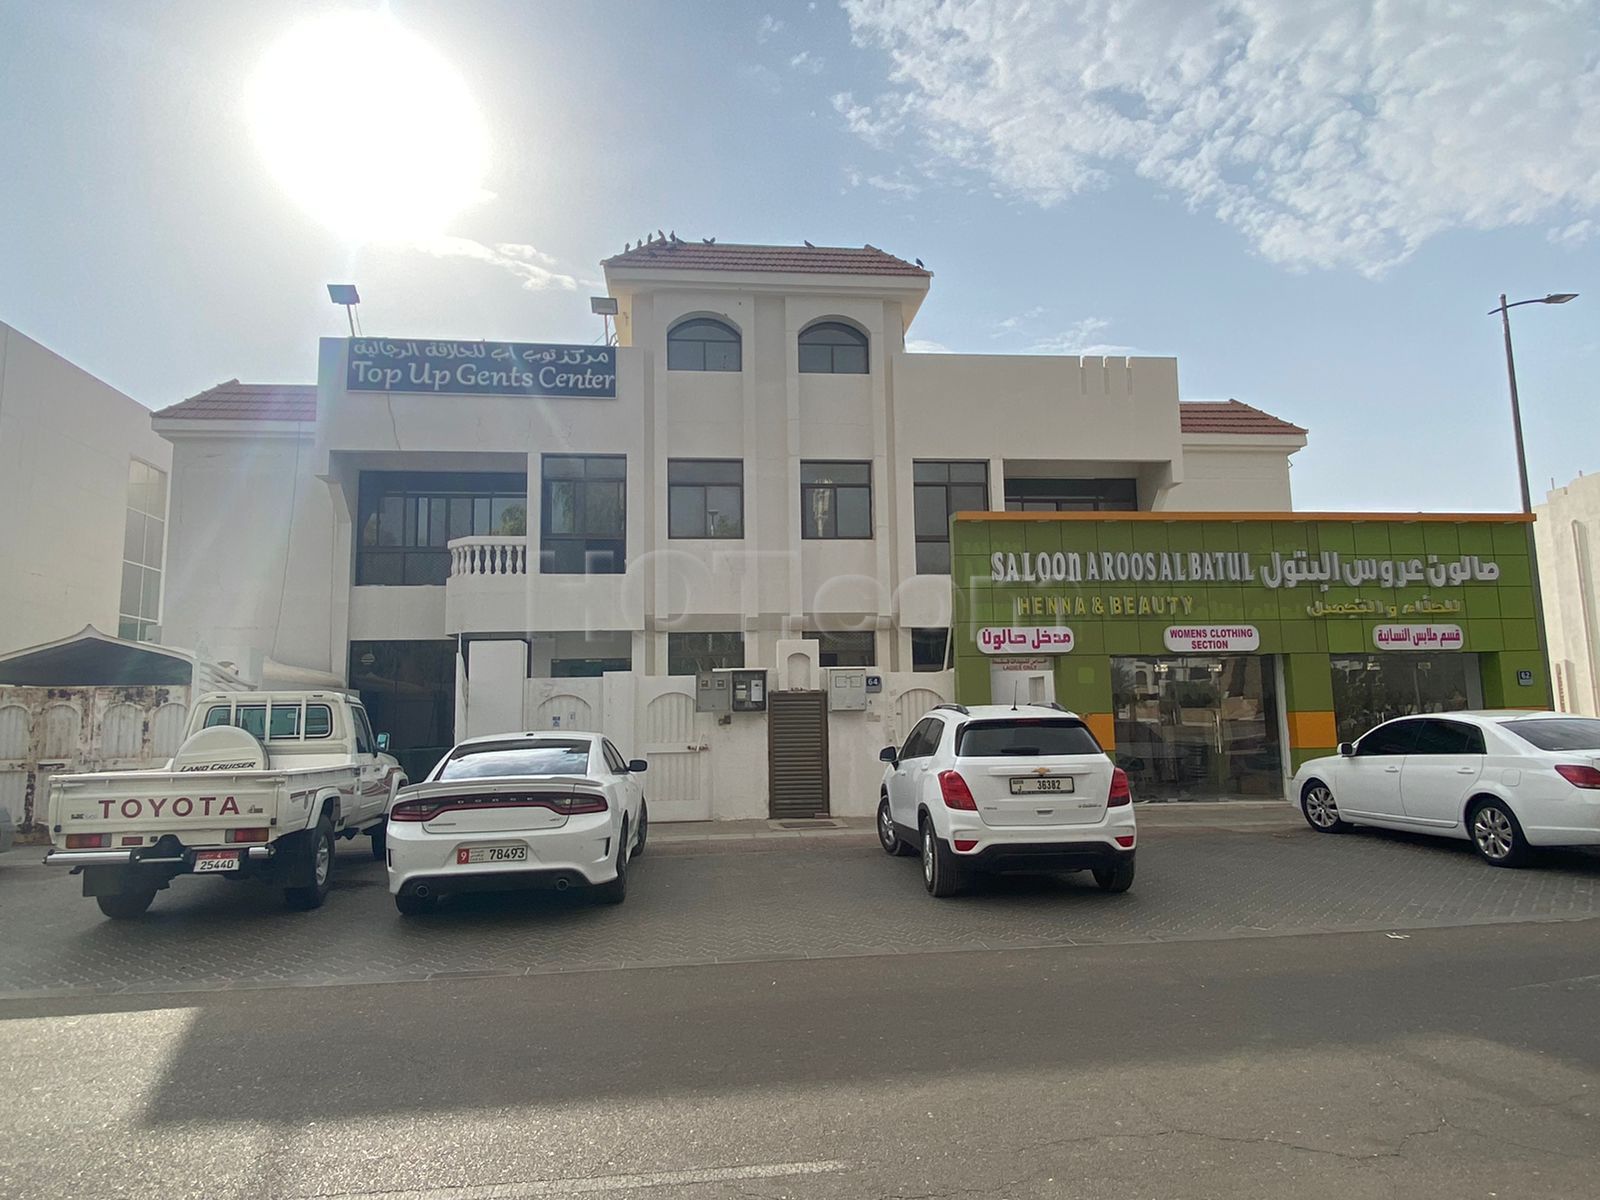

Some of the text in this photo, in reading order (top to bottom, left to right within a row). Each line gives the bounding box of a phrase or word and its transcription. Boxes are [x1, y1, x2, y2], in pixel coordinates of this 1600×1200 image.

[353, 340, 420, 359] الرجالية
[425, 342, 486, 359] للحلاقة
[522, 348, 557, 364] توب
[557, 349, 609, 365] مركز
[352, 361, 616, 391] Top Up Gents Center
[1188, 551, 1255, 582] BATUL
[1260, 550, 1500, 592] صالون عروس البتول
[1016, 596, 1193, 616] HENNA & BEAUTY
[982, 628, 1071, 650] مدخل صالون
[1169, 628, 1253, 639] WOMENS CLOTHING
[1412, 627, 1438, 647] ملابس
[1440, 629, 1461, 647] قسم
[1191, 640, 1229, 650] SECTION
[98, 795, 240, 819] TOYOTA
[460, 851, 467, 861] 9
[489, 847, 525, 860] 78493
[200, 860, 234, 870] 25440
